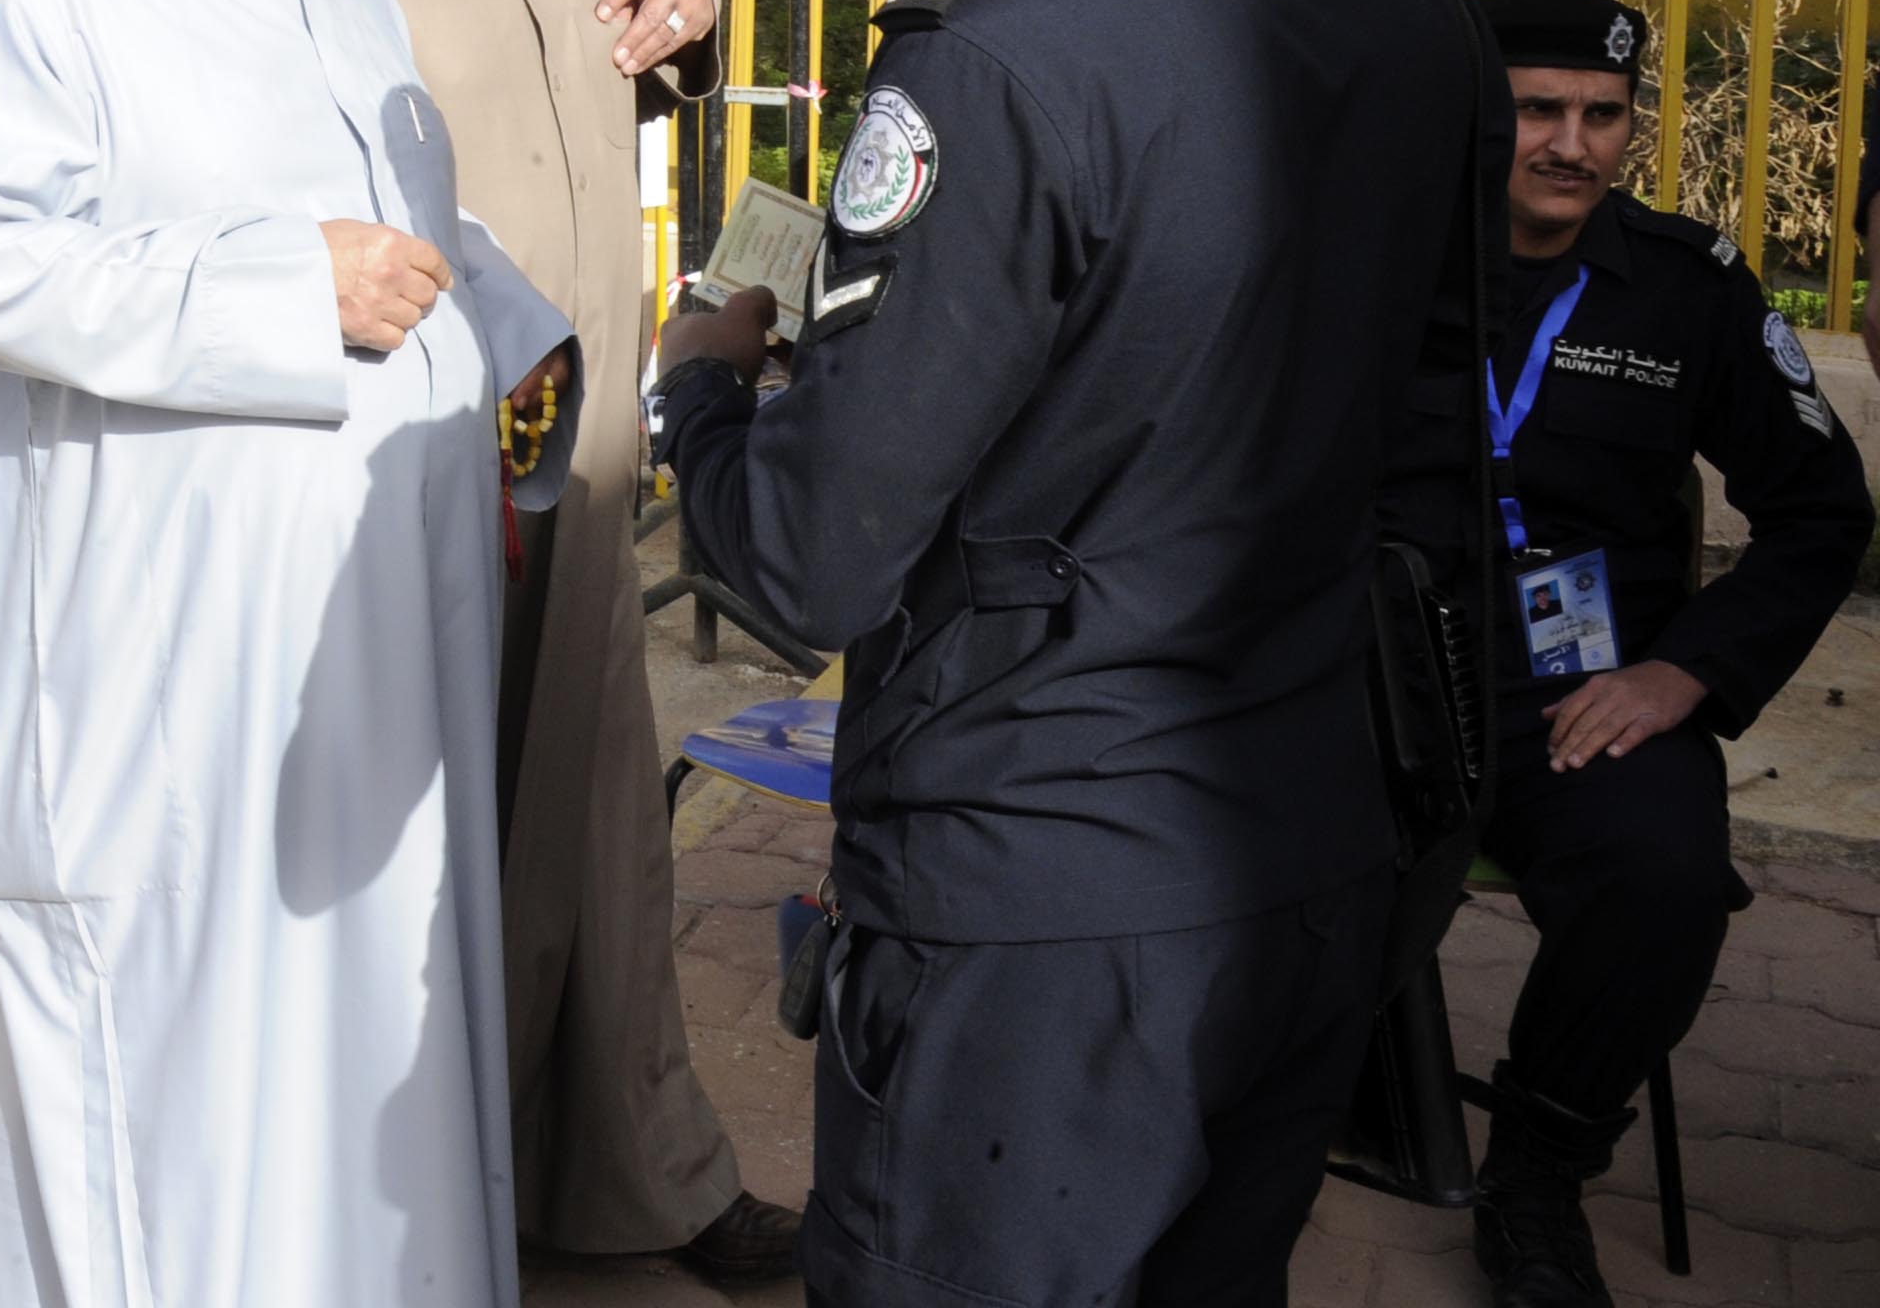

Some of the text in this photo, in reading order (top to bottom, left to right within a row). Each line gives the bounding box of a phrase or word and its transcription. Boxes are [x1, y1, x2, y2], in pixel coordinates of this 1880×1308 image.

[1554, 340, 1681, 373] شرطة الكويت
[1554, 355, 1678, 389] KUWAIT POLICE
